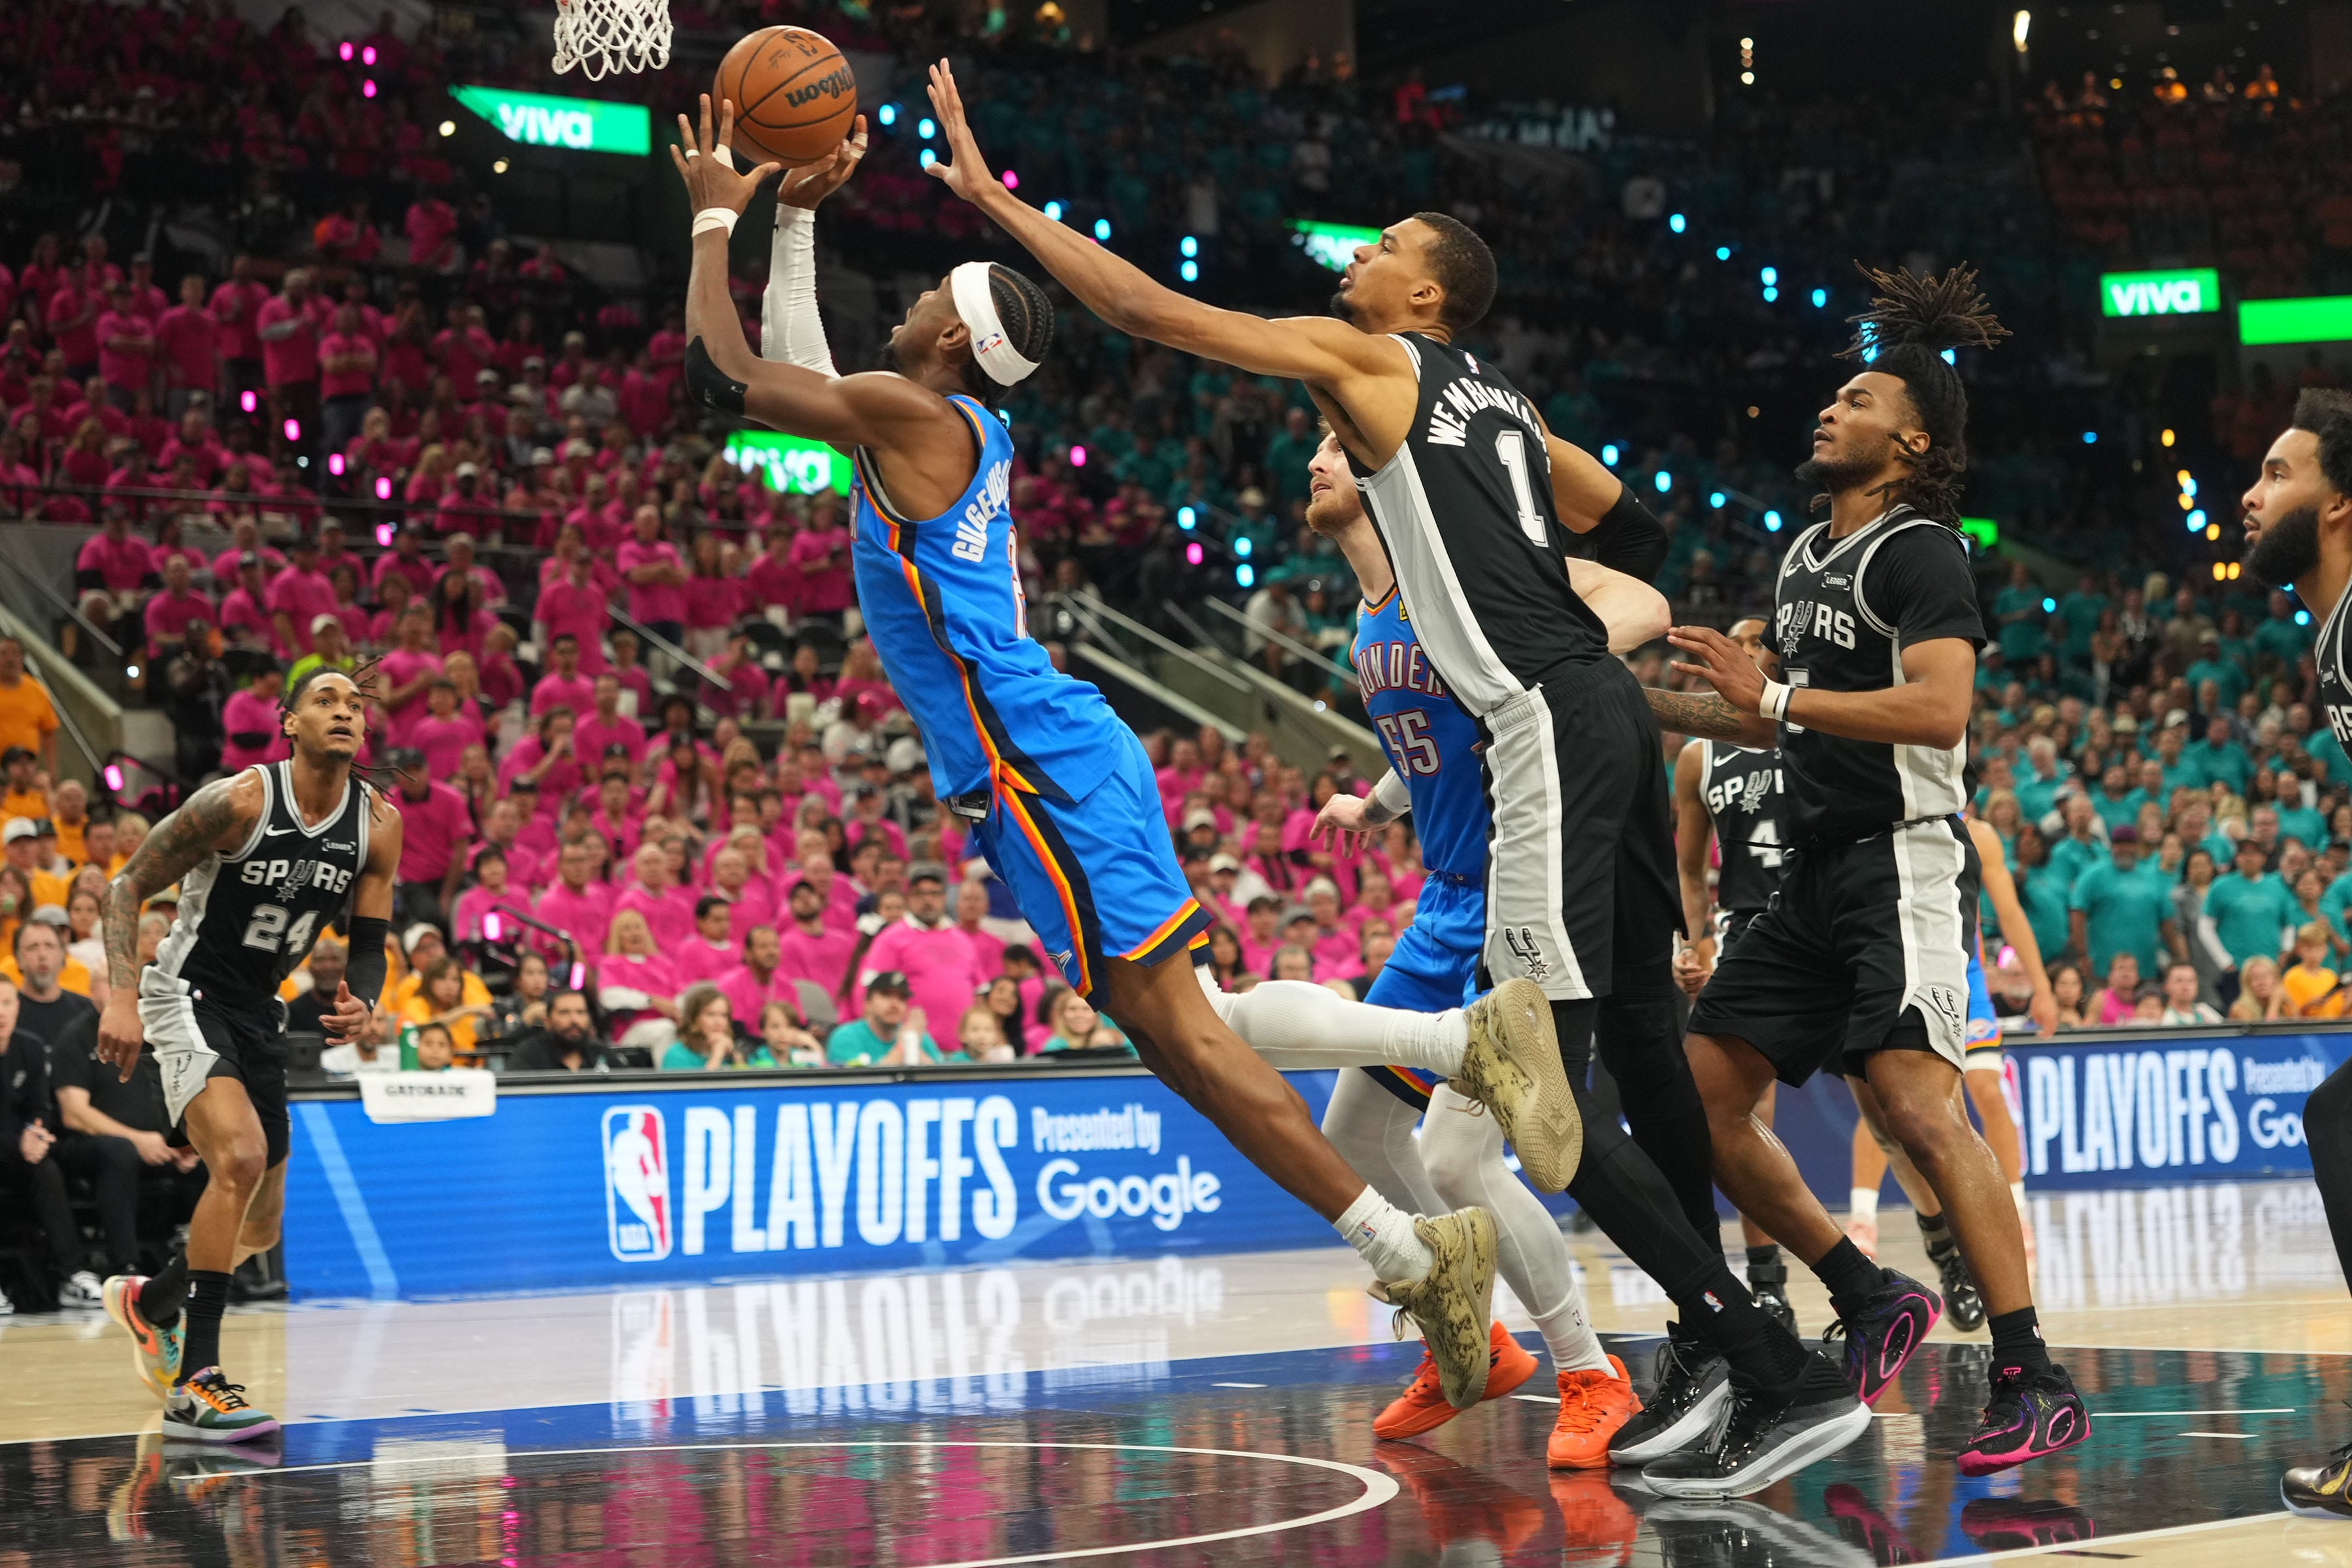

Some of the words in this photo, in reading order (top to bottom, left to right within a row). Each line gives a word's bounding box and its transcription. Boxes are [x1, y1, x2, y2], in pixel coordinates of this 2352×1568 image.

[785, 64, 856, 108] Wilson
[1495, 430, 1549, 547] 1
[1374, 708, 1442, 779] 55
[1747, 818, 1784, 869] 4
[240, 859, 353, 900] SPURS
[241, 904, 319, 955] 24
[1031, 1103, 1134, 1153] Presented
[2028, 1048, 2240, 1175] PLAYOFFS
[2248, 1098, 2308, 1149] Go
[683, 1096, 1018, 1256] PLAYOFFS
[1036, 1154, 1222, 1232] Google
